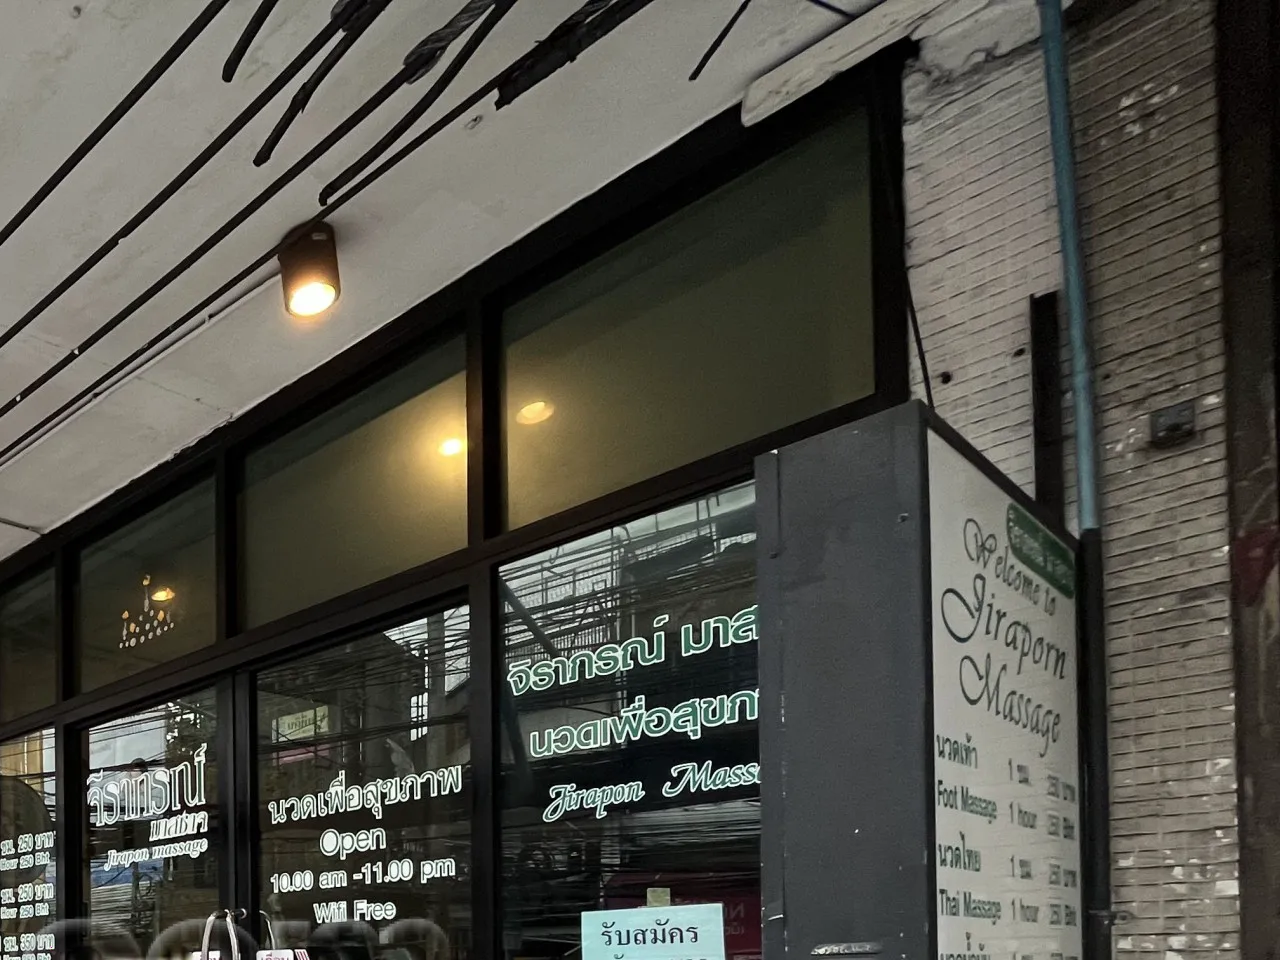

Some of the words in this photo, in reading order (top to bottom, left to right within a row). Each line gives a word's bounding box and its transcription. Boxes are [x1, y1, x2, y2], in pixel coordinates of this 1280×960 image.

[963, 518, 1040, 605] Welcome
[941, 573, 1066, 680] Jiraporn
[959, 653, 1061, 758] Massage
[268, 765, 462, 824] นวดเพื่อสุขภาพ
[543, 781, 645, 822] Jirapon
[662, 760, 761, 797] Mass
[937, 780, 958, 810] Foot
[104, 848, 149, 871] Jirapon
[152, 838, 208, 858] massage
[320, 828, 386, 860] Open
[270, 870, 313, 893] 10.00
[319, 870, 347, 888] am
[421, 858, 455, 883] pm
[313, 901, 347, 923] Wifi
[354, 900, 396, 922] Free
[939, 889, 960, 917] Thai
[601, 918, 698, 946] รับสมัคร
